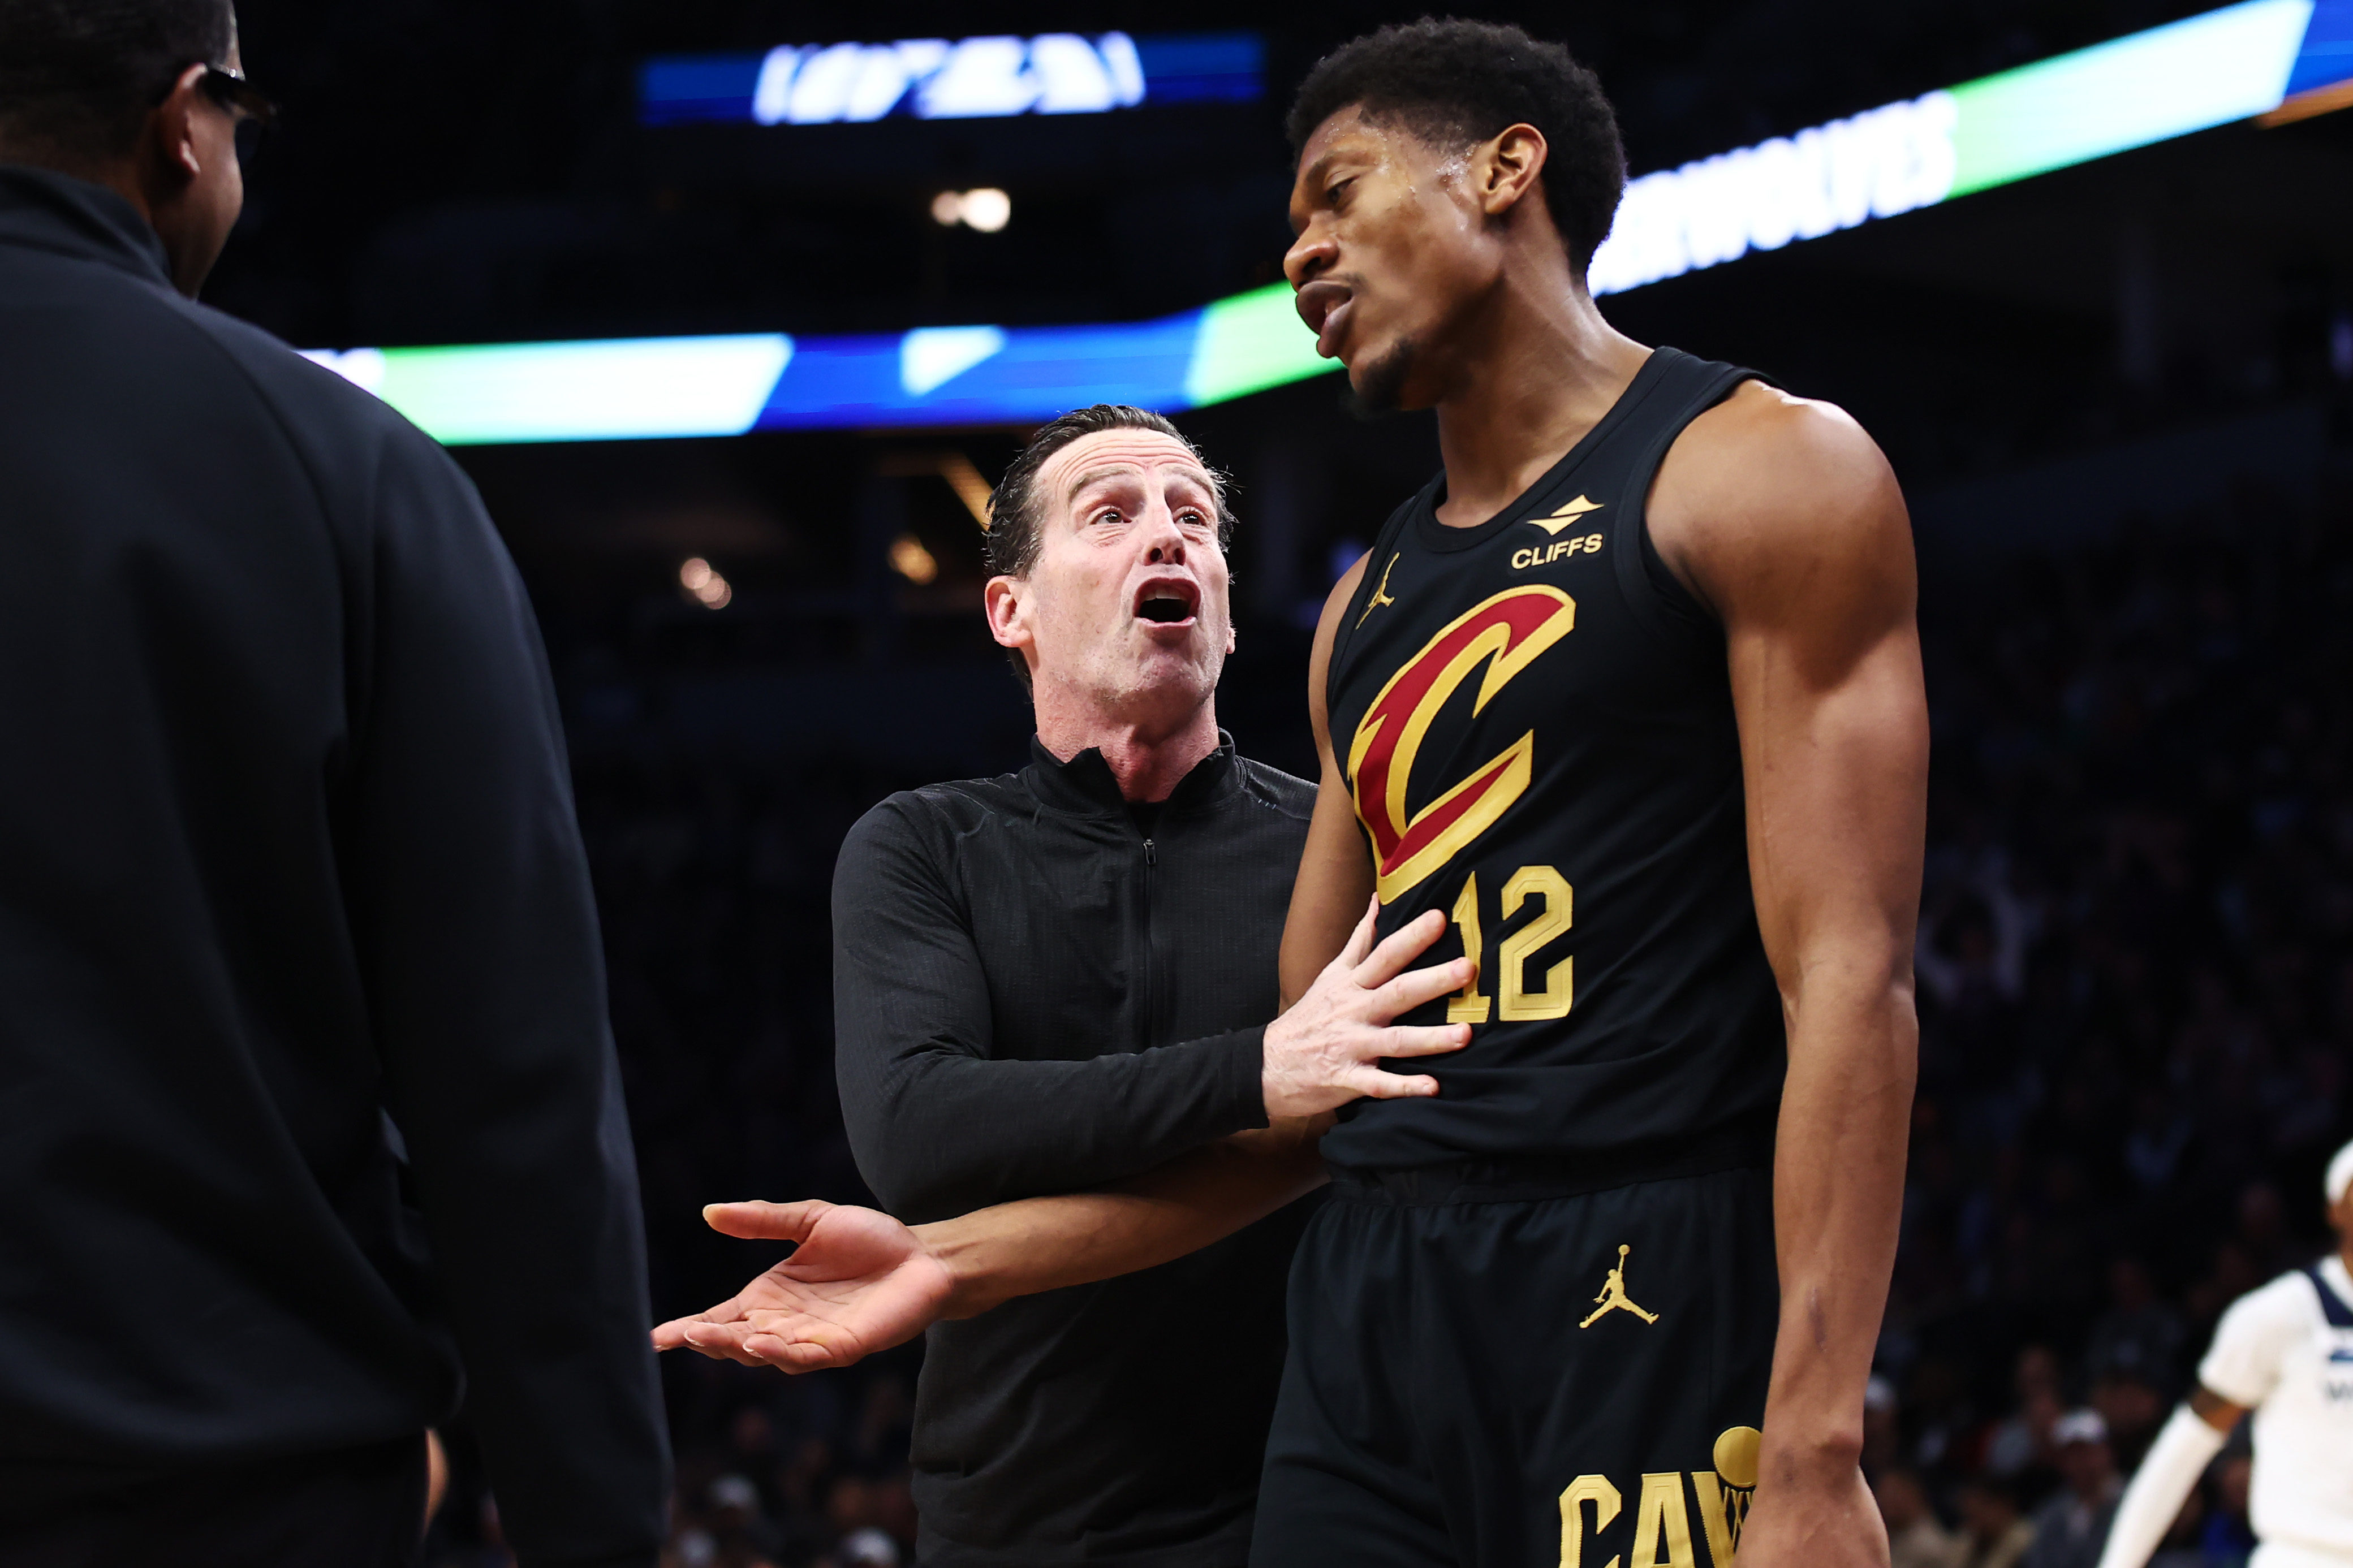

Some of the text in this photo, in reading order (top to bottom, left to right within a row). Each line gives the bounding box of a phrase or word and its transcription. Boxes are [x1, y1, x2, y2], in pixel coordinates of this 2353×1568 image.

[1511, 533, 1604, 570] CLIFFS
[1347, 583, 1576, 906] C
[1446, 865, 1574, 1023] 12
